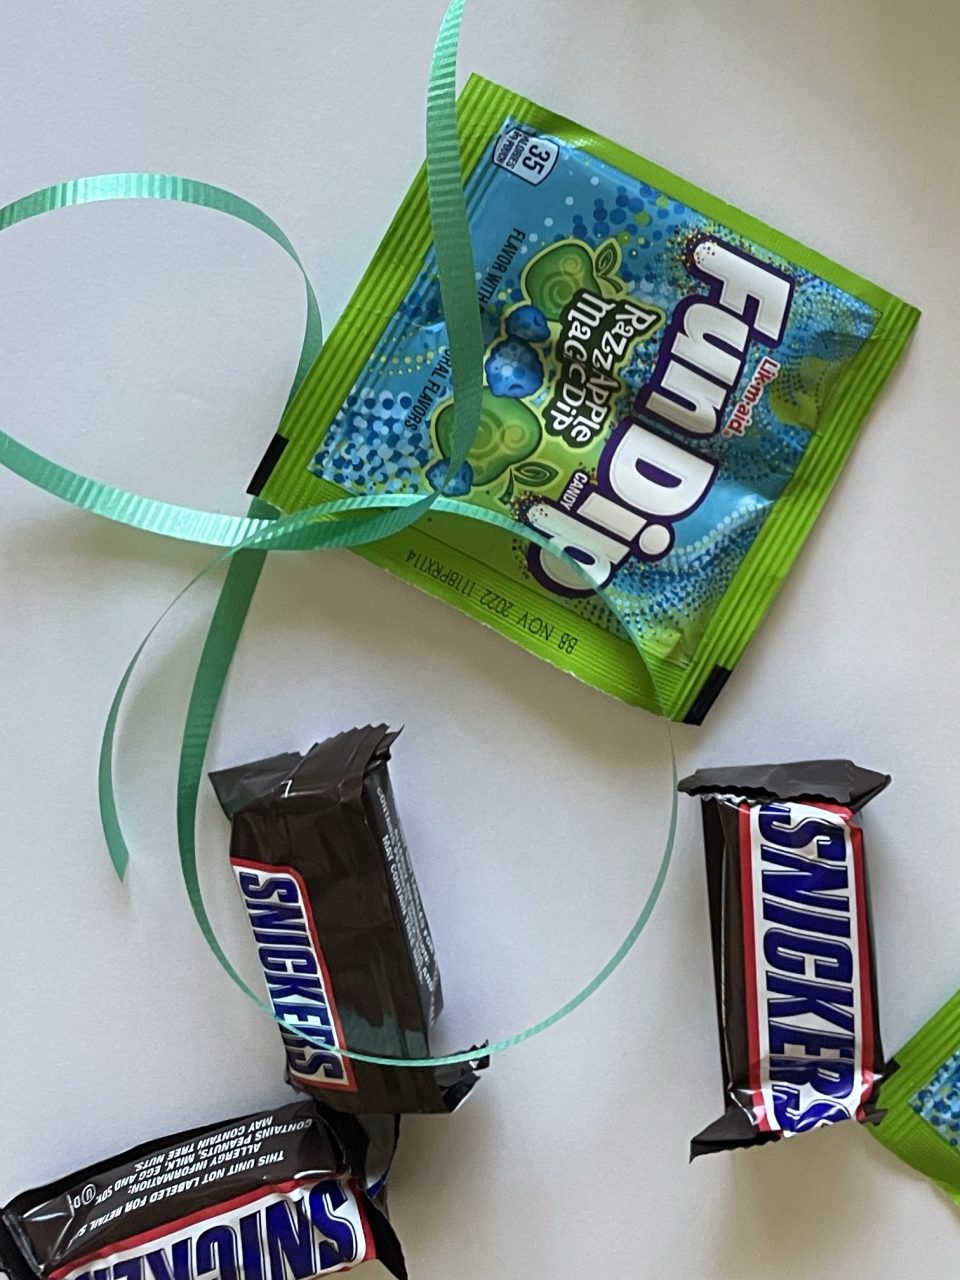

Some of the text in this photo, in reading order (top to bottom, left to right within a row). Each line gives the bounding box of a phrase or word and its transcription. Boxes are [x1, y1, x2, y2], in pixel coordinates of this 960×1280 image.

[505, 133, 529, 169] ALORIES
[520, 143, 552, 175] 35
[477, 227, 526, 304] FLAVOR WITH
[403, 348, 452, 431] URAL FLAVORS
[523, 239, 791, 591] Fun Dip
[555, 471, 588, 511] CANDY
[477, 587, 514, 618] 2022
[515, 609, 555, 641] NOV
[555, 631, 578, 655] BB
[381, 833, 394, 861] MAY
[389, 862, 407, 916] CONTAIN
[239, 871, 344, 1080] SNICKERS
[133, 1115, 274, 1172] MAY CONTAIN TREE NUTS.
[199, 1133, 253, 1158] PEANUTS,
[255, 1117, 313, 1139] CONTAINS
[127, 1141, 263, 1194] ALLERGY INFORMATION:
[139, 1164, 162, 1180] EGG
[164, 1152, 196, 1170] MILK,
[89, 1149, 285, 1231] THIS UNIT NOT LABELED FOR RETAIL
[114, 1173, 138, 1191] AND
